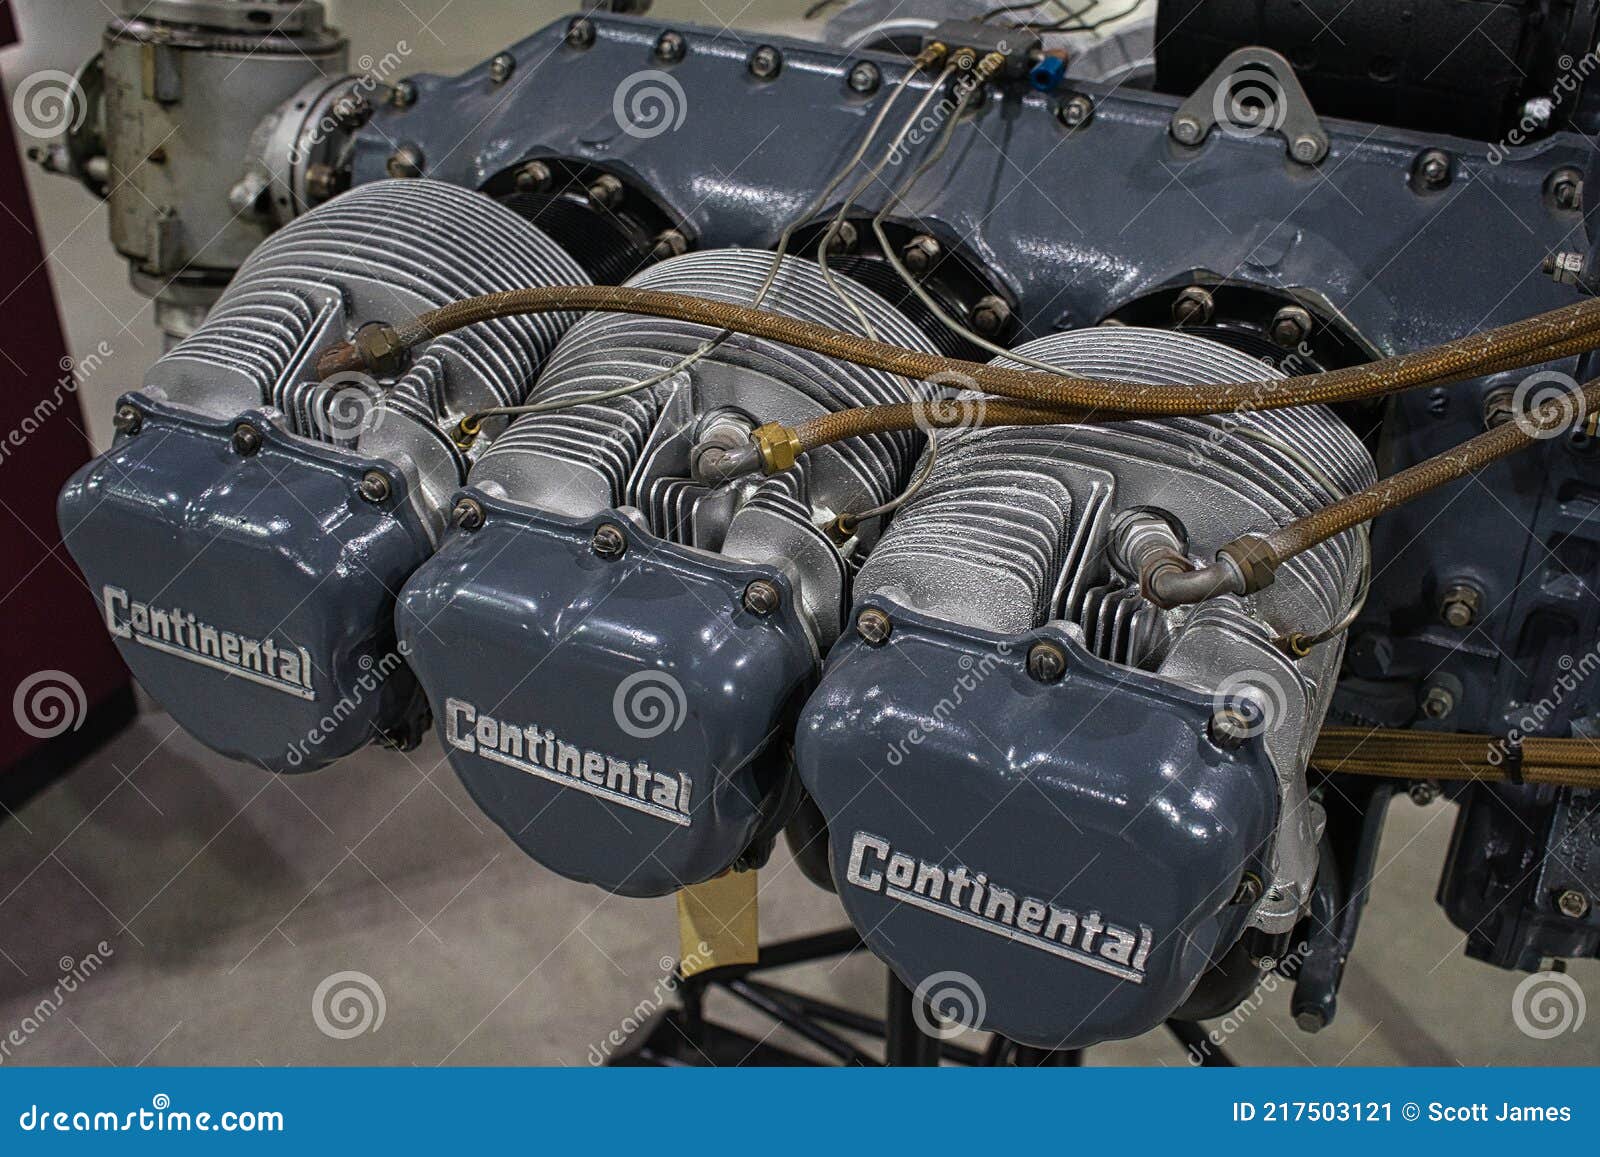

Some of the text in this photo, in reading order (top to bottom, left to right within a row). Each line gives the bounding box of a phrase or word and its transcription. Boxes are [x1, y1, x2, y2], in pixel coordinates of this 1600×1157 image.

[103, 584, 313, 691] Continental
[446, 698, 692, 814] Continental
[847, 831, 1153, 971] Continental
